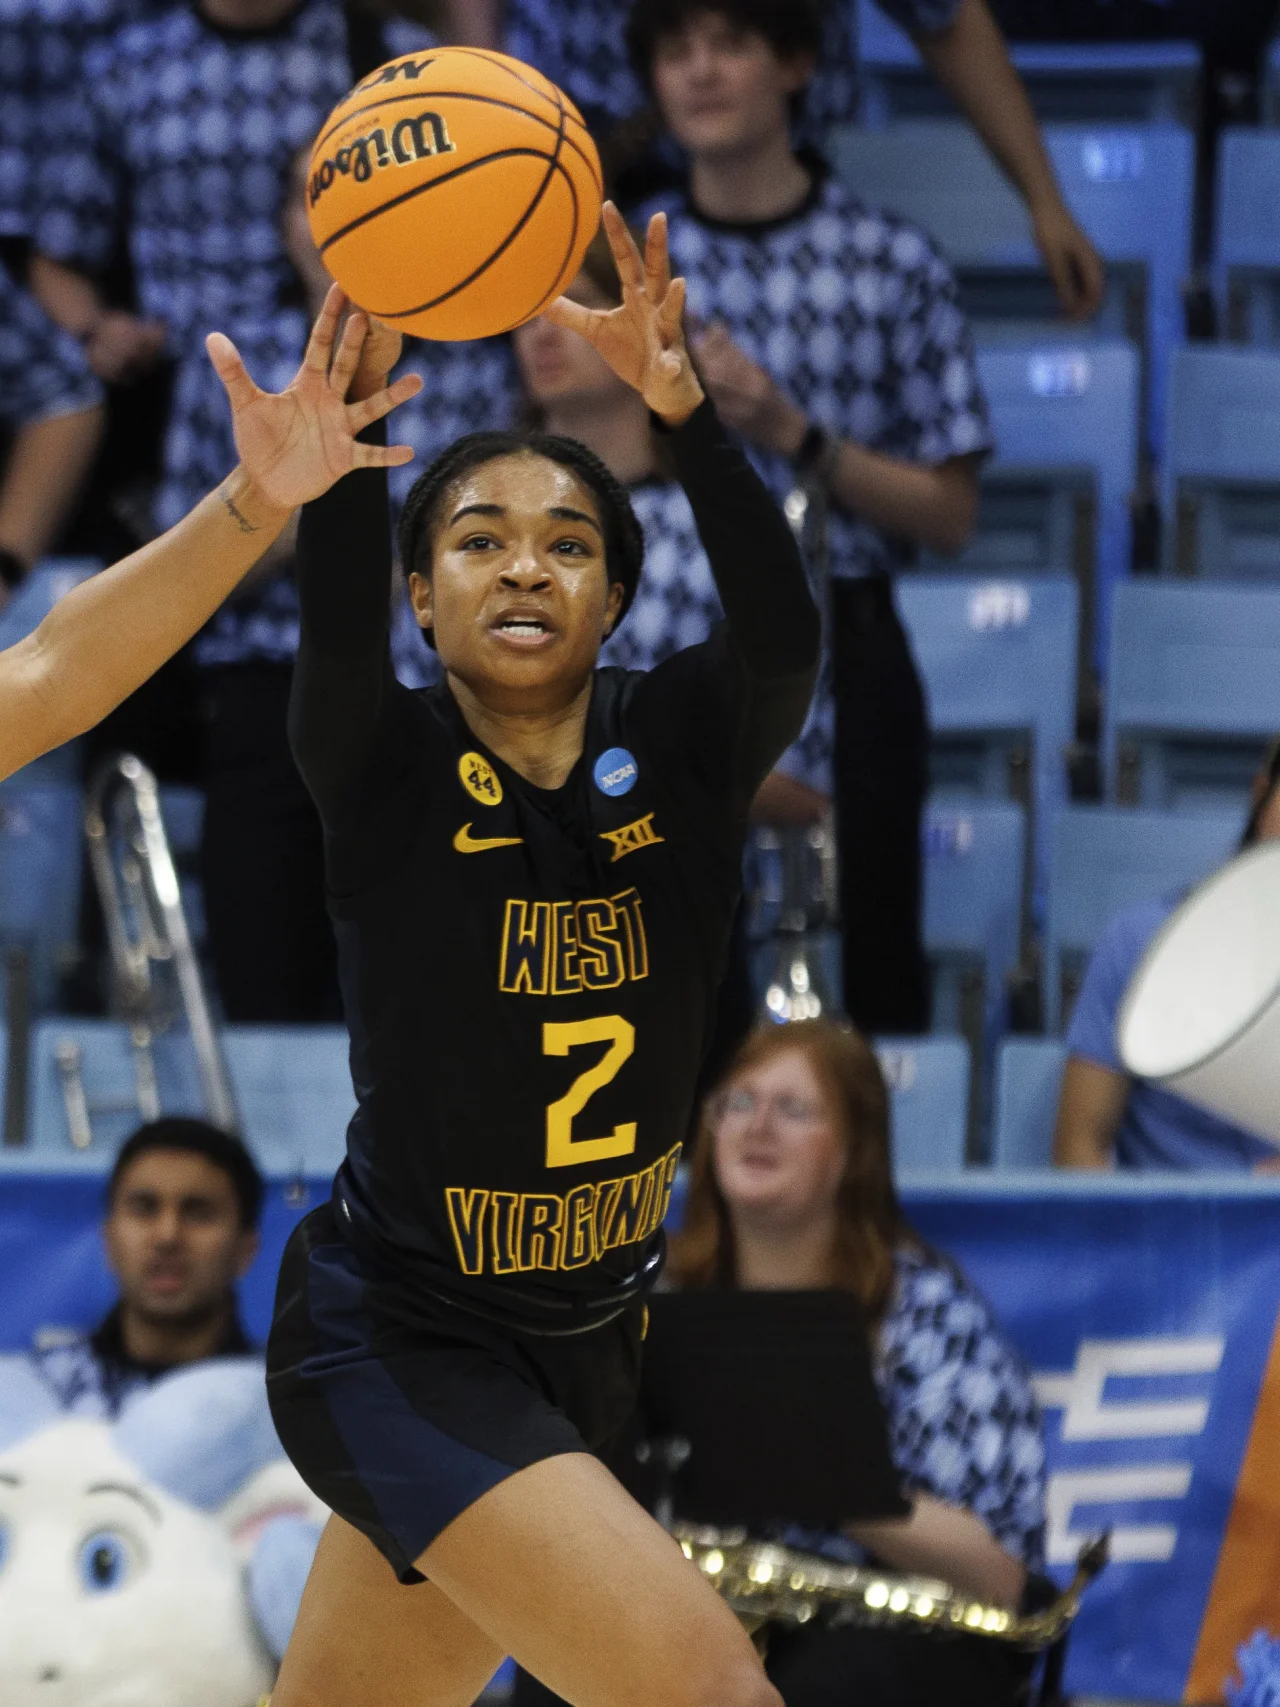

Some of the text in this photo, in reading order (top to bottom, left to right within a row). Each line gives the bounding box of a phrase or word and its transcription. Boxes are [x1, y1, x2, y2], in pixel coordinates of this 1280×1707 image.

[308, 111, 456, 208] Wilson
[600, 763, 636, 789] NCAA
[599, 811, 666, 863] XII
[499, 887, 649, 996] WEST
[542, 1014, 637, 1169] 2
